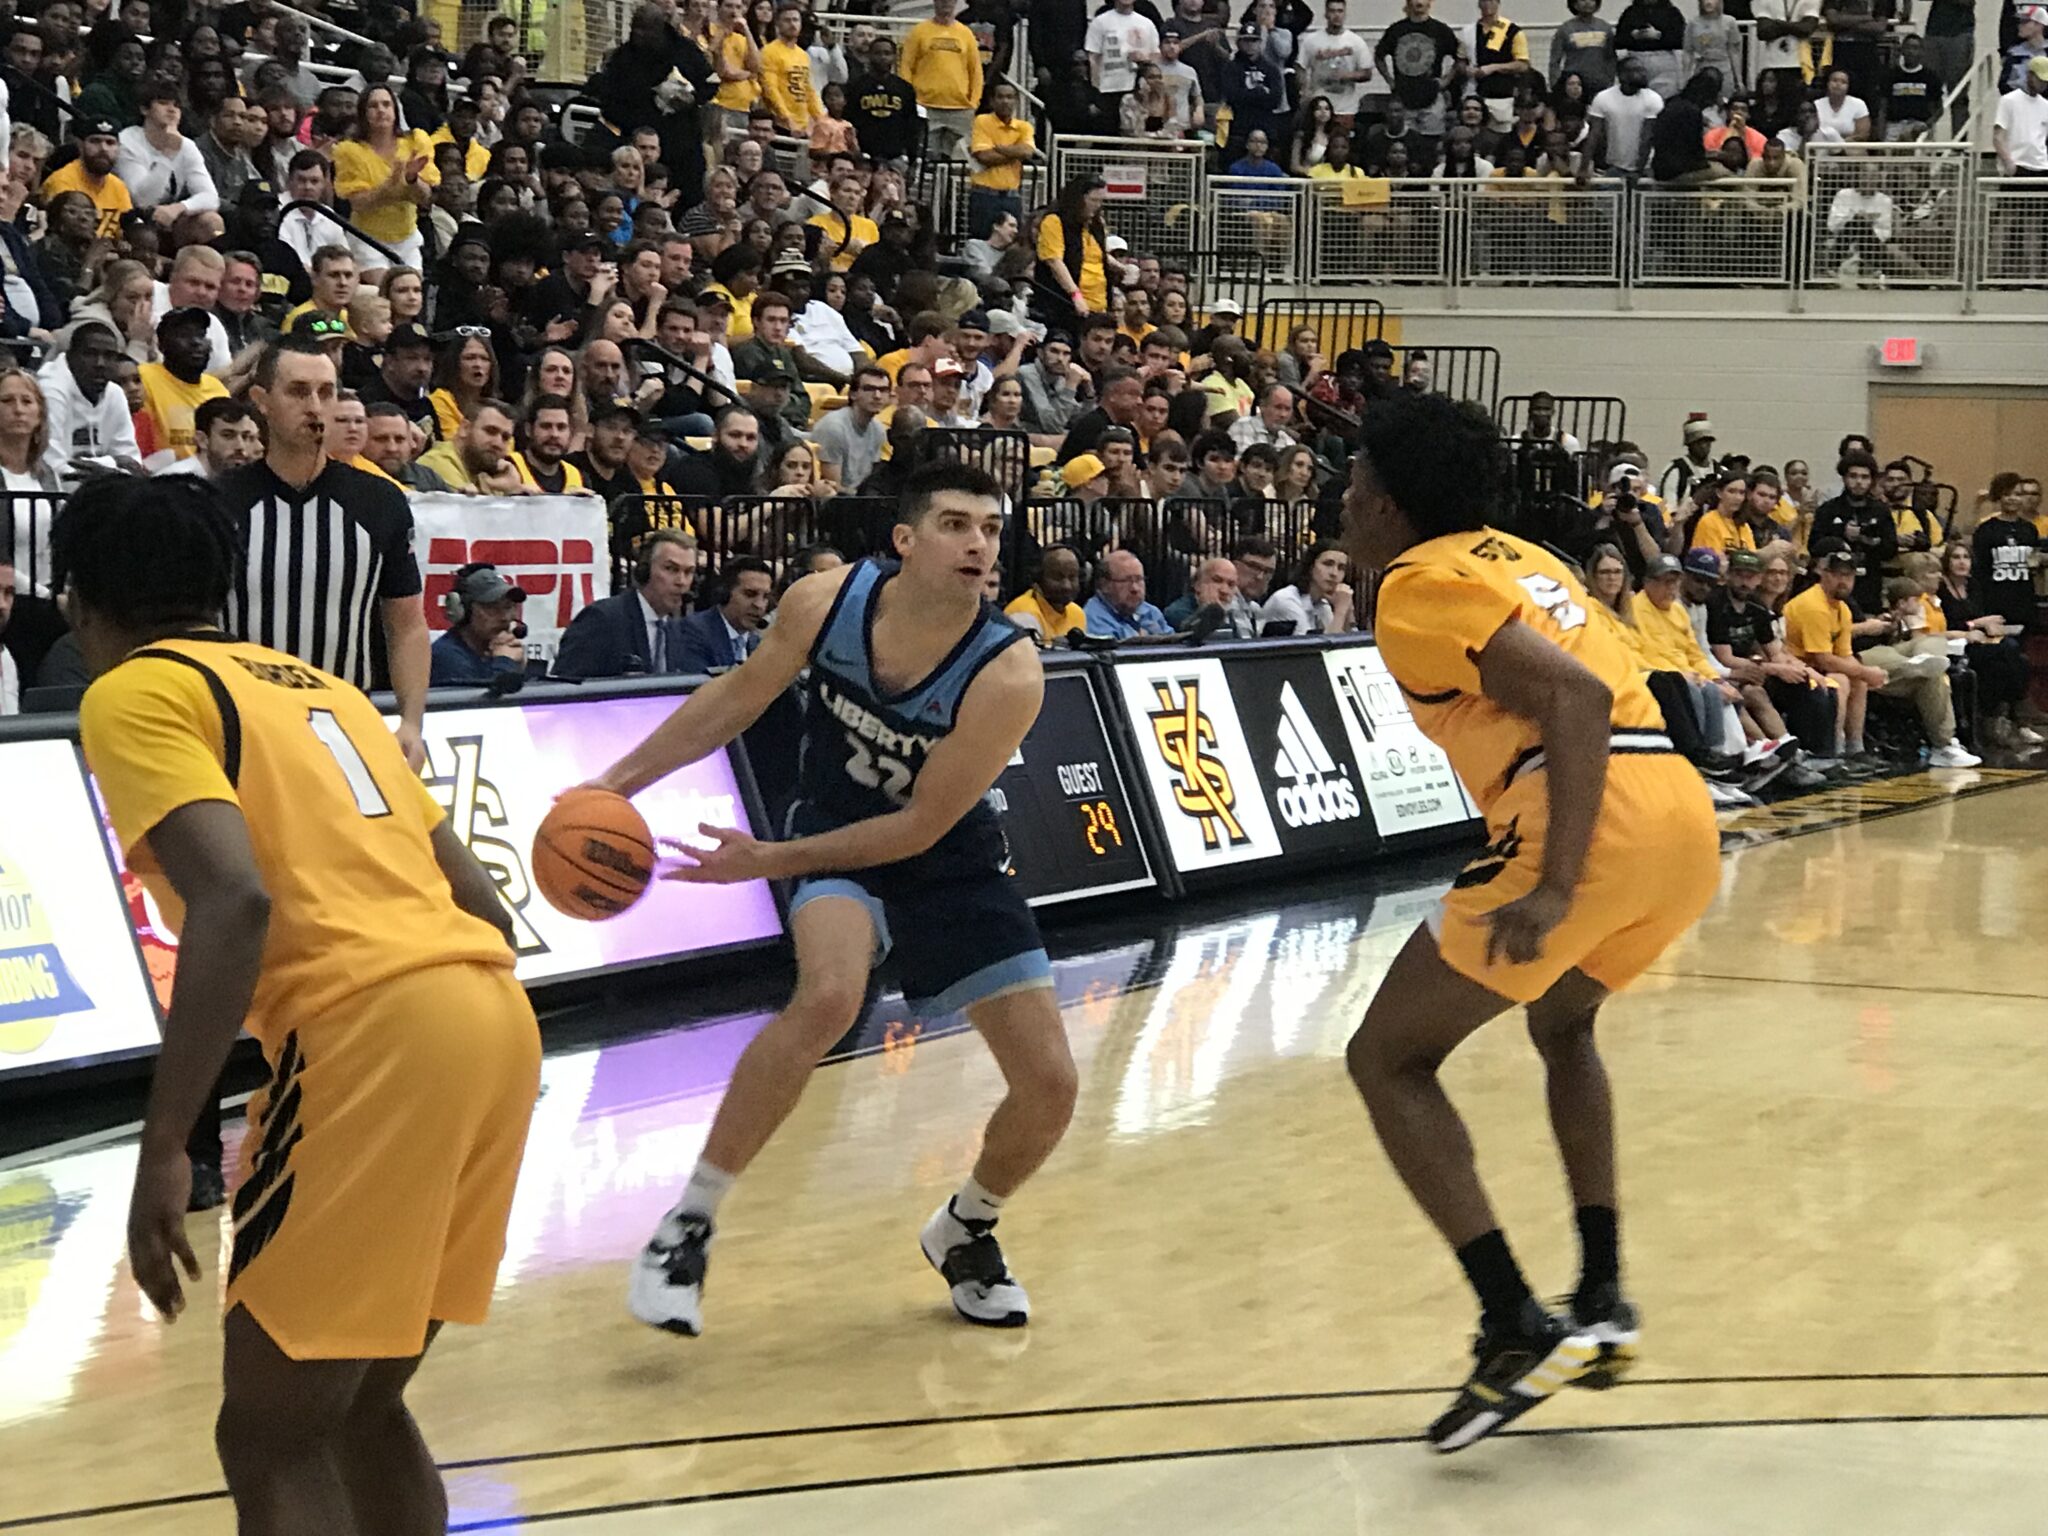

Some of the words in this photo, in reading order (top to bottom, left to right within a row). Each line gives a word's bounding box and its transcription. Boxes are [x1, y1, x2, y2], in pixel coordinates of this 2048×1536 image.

[860, 95, 902, 111] OWLS
[820, 682, 941, 757] LIBERTY
[306, 707, 393, 818] 1
[845, 731, 912, 805] 22
[1057, 762, 1104, 795] GUEST
[1277, 772, 1361, 828] adidas
[1080, 802, 1123, 855] 29
